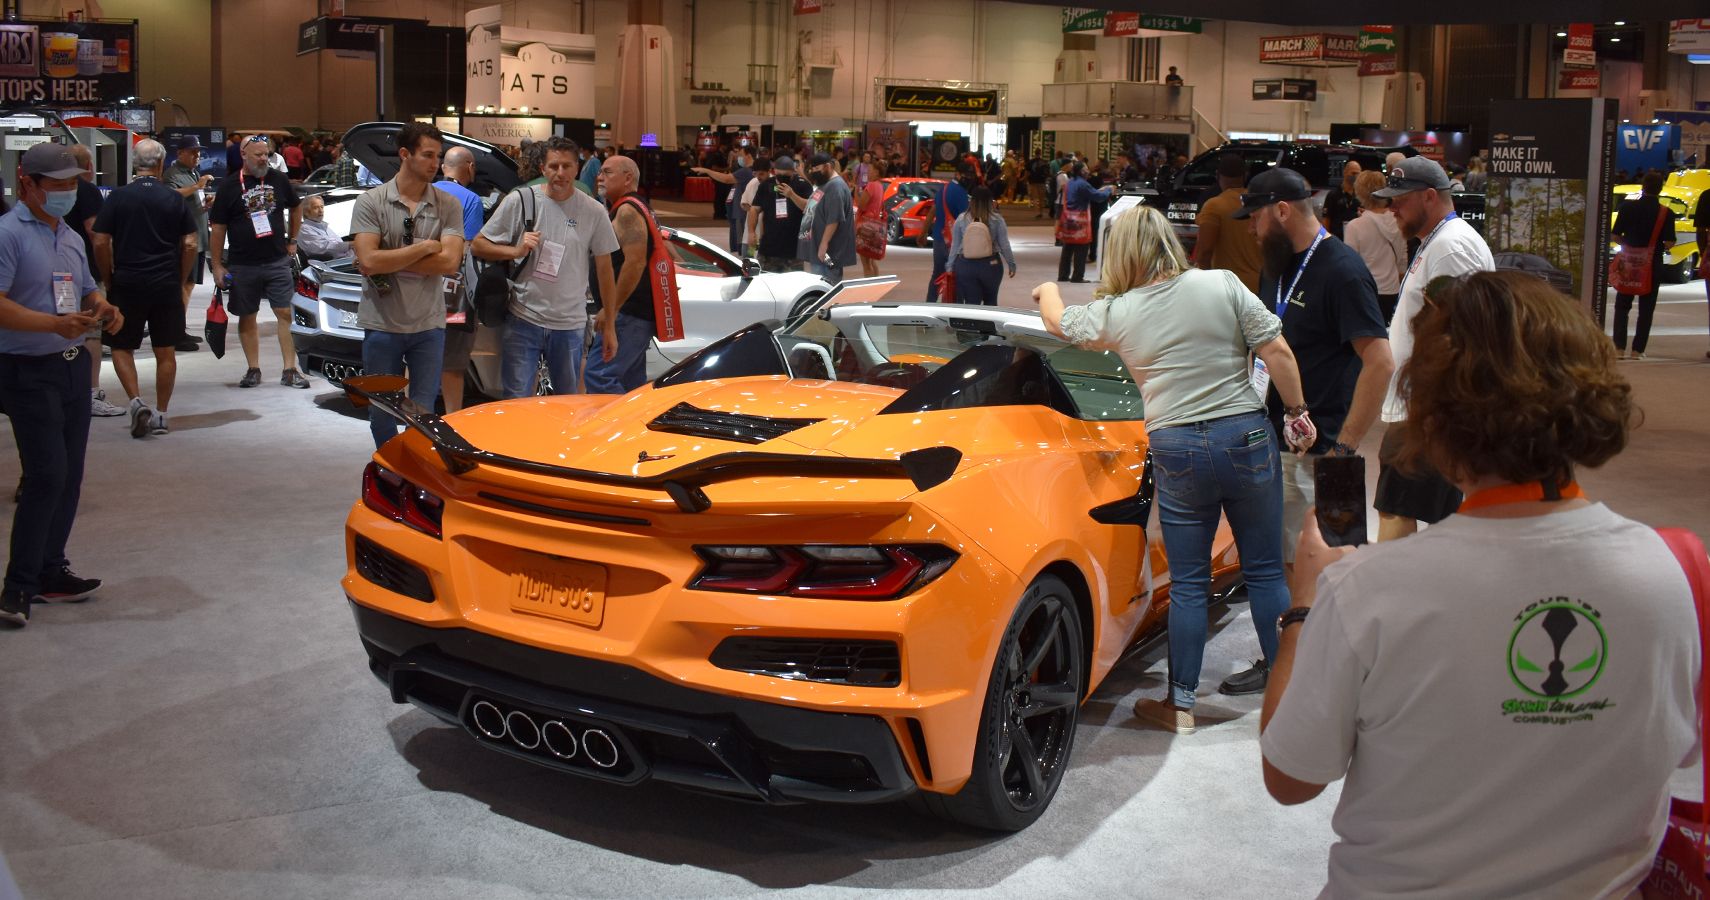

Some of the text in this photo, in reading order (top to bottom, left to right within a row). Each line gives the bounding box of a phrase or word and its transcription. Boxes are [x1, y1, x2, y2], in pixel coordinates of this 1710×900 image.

[339, 23, 379, 34] LEE
[1263, 39, 1303, 52] MARCH
[1326, 38, 1359, 51] MARC
[53, 80, 102, 101] HERE.
[483, 128, 533, 138] AMERICA
[1623, 129, 1665, 152] CVF
[1492, 147, 1539, 160] MAKE IT
[1492, 160, 1556, 174] YOUR OWN.
[660, 275, 676, 338] SPYDER
[1513, 596, 1569, 622] TOUR
